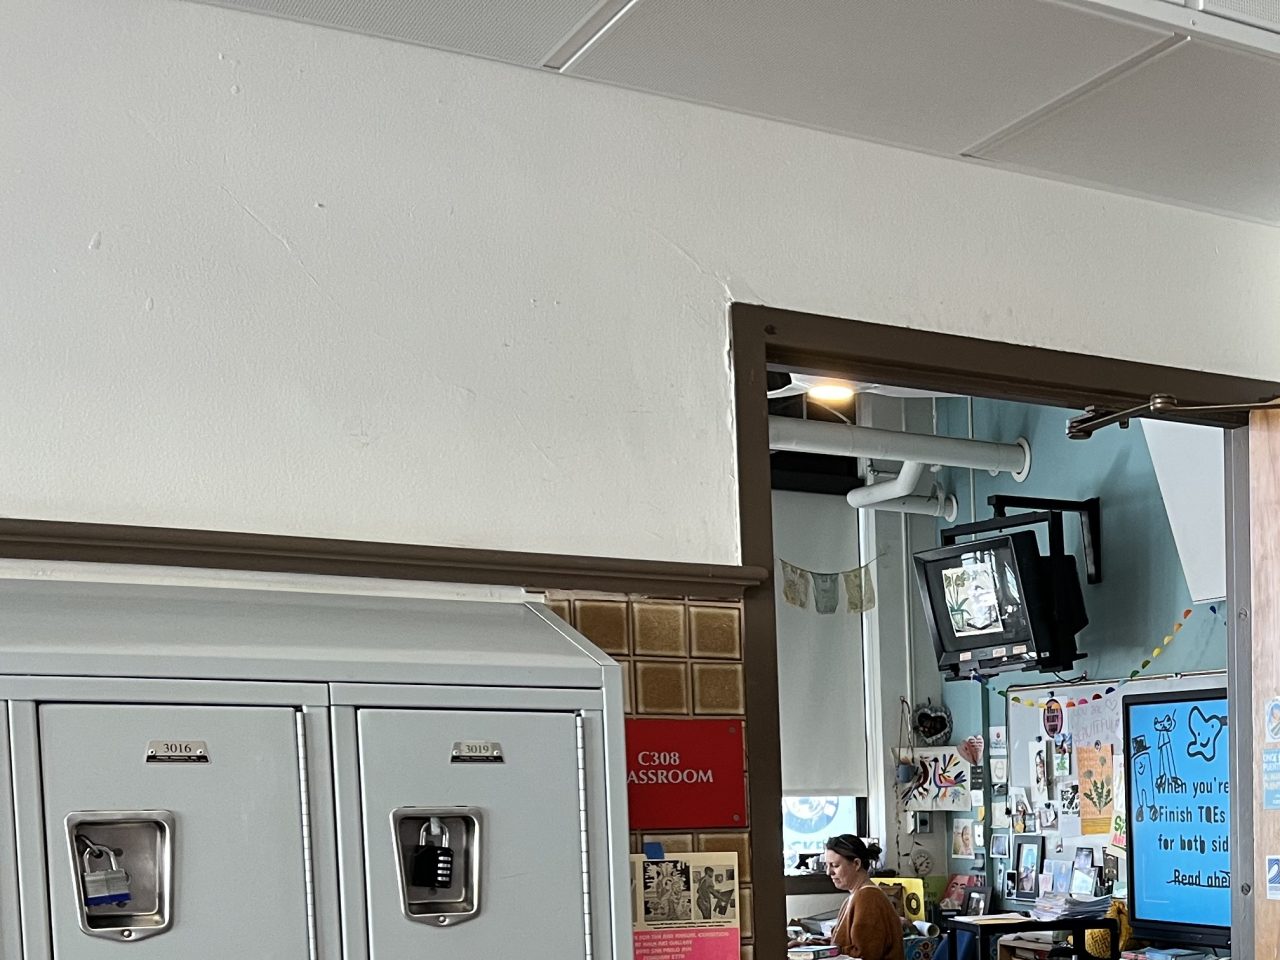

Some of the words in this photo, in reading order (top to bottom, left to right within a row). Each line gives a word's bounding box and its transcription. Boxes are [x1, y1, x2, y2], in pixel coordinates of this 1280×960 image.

[163, 743, 192, 754] 3016
[465, 744, 489, 754] 3019
[637, 751, 680, 766] C308
[626, 769, 714, 784] ASSROOM
[1156, 774, 1187, 794] When
[1192, 776, 1229, 799] you're
[1159, 806, 1192, 823] Finish
[1158, 833, 1175, 851] for
[1212, 835, 1229, 853] sid
[1173, 869, 1201, 886] Read
[1206, 870, 1230, 888] ahe
